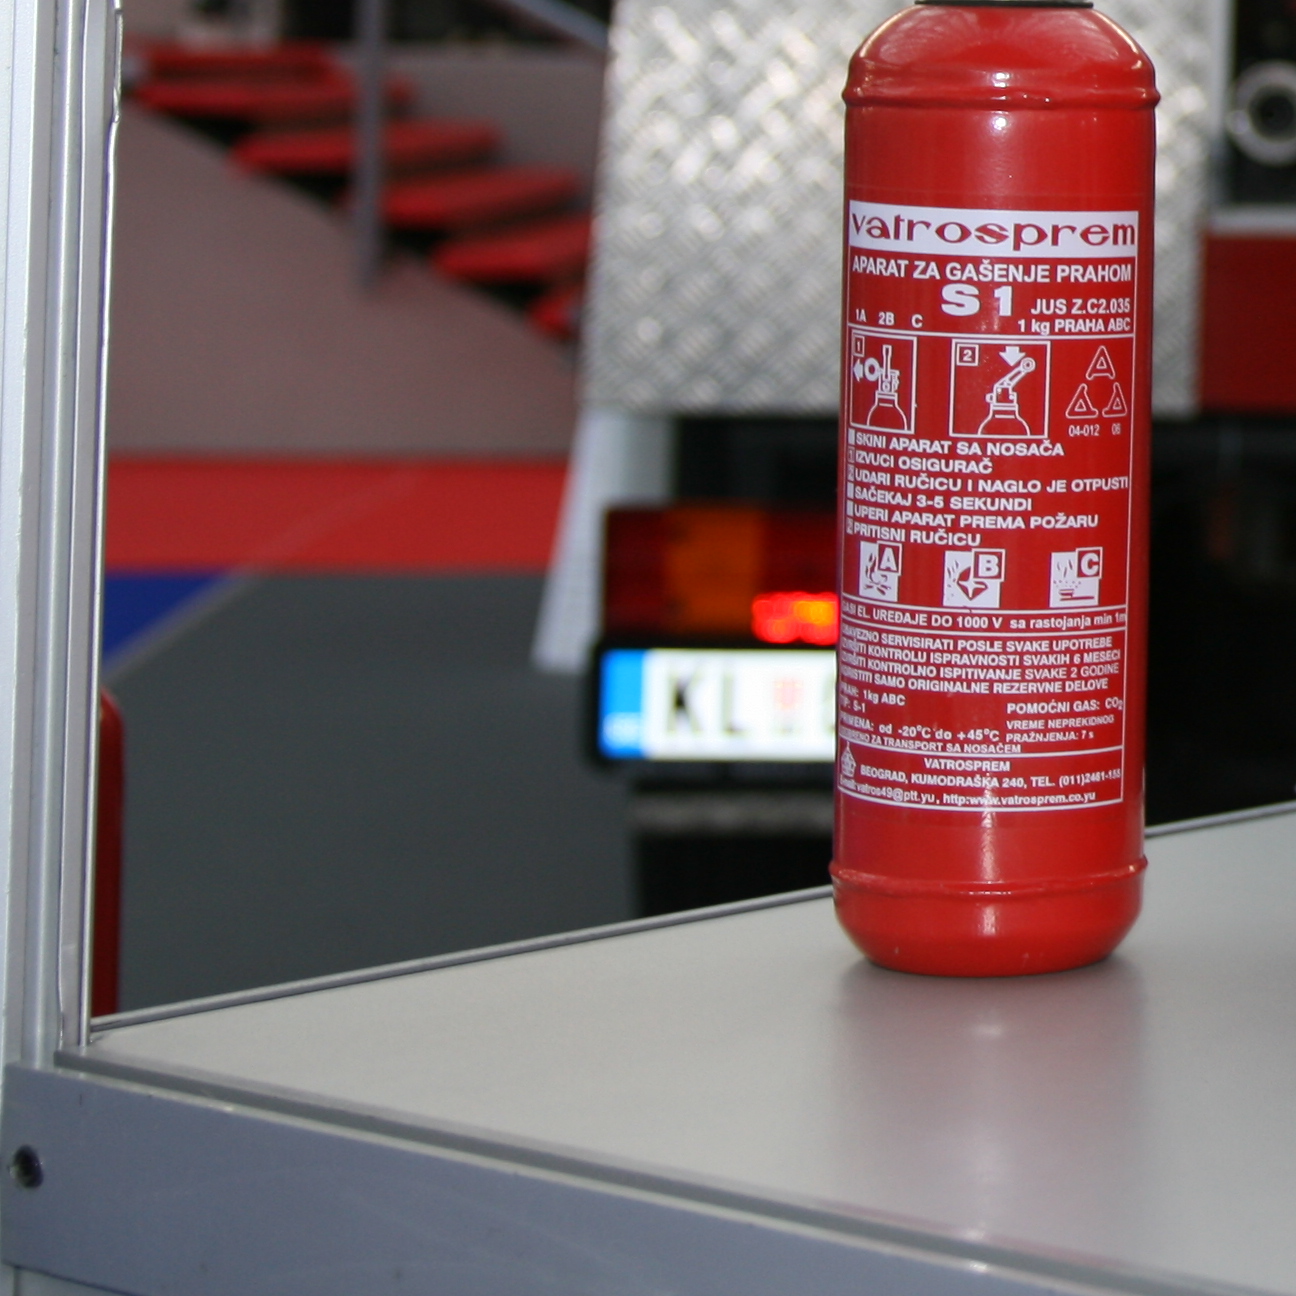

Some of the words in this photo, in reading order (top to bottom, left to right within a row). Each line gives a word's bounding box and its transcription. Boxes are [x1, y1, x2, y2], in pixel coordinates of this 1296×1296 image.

[851, 213, 1135, 251] vatrosprem
[852, 256, 908, 277] APARAT
[912, 261, 940, 279] ZA
[946, 259, 1050, 282] GAŠENJE
[1056, 264, 1131, 282] PRAHOM
[940, 284, 980, 316] S
[994, 286, 1012, 316] 1
[1031, 299, 1067, 314] JUS
[879, 312, 894, 325] 2B
[911, 314, 923, 328] C
[1018, 320, 1025, 332] 1
[1031, 320, 1050, 335] kg
[1054, 319, 1105, 332] PRAHA
[1108, 319, 1131, 331] ABC
[856, 434, 885, 447] SKINI
[889, 438, 952, 454] APARAT
[957, 441, 982, 455] SA
[987, 439, 1064, 456] NOSAČA
[856, 451, 894, 467] IZVUCI
[898, 456, 993, 474] OSIGURAČ
[855, 469, 891, 484] UDARI
[894, 474, 961, 491] RUČICU
[968, 479, 972, 491] I
[978, 479, 1042, 494] NAGLO
[1046, 479, 1066, 493] JE
[1071, 476, 1128, 492] OTPUSTI
[855, 485, 912, 506] SAČEKAJ
[917, 495, 944, 509] 3-5
[950, 497, 1032, 511] SEKUNDI
[854, 503, 888, 520] UPERI
[892, 510, 955, 527] APARAT
[960, 515, 1025, 529] PREMA
[1030, 513, 1098, 529] POŽARU
[853, 523, 905, 542] PRITISNI
[910, 529, 981, 546] RUČICU
